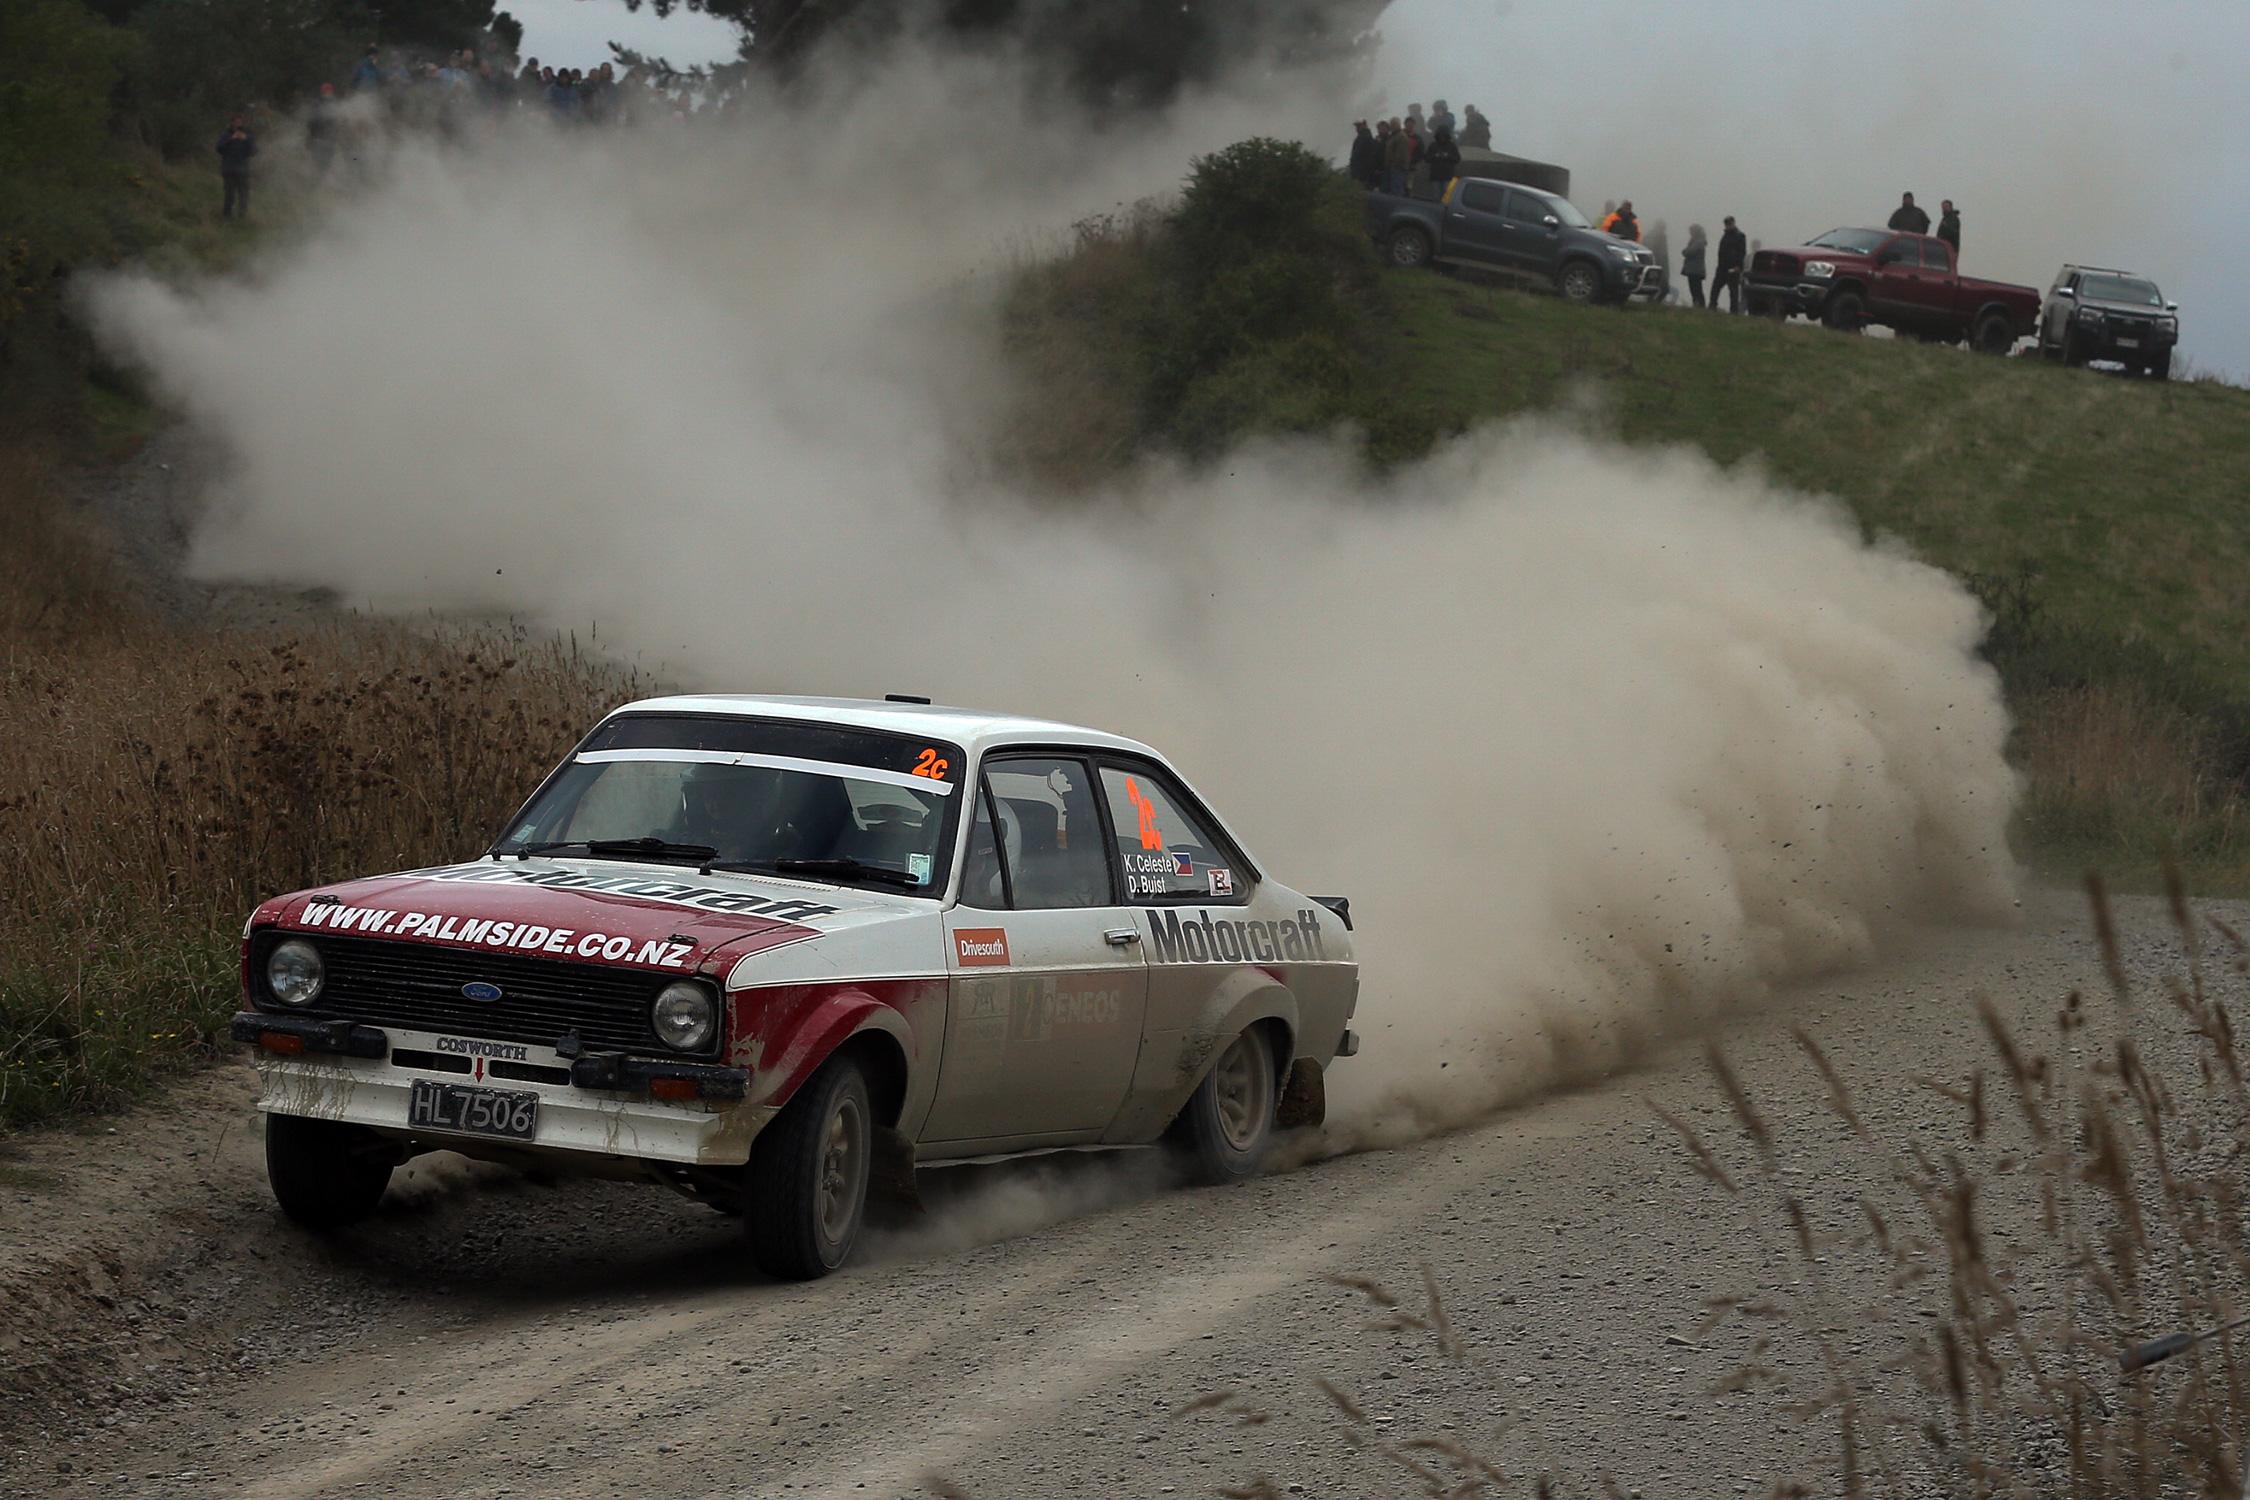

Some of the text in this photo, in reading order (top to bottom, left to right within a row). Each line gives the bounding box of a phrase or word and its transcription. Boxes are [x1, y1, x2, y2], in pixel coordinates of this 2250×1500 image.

[1123, 854, 1173, 873] K. Celeste
[1128, 875, 1167, 894] D. Buist
[300, 903, 698, 968] WWW.PALMSIDE.CO.NZ
[1146, 909, 1327, 963] Motorcraft
[960, 938, 1004, 956] Drivesouth
[436, 1037, 528, 1061] COSWORTH
